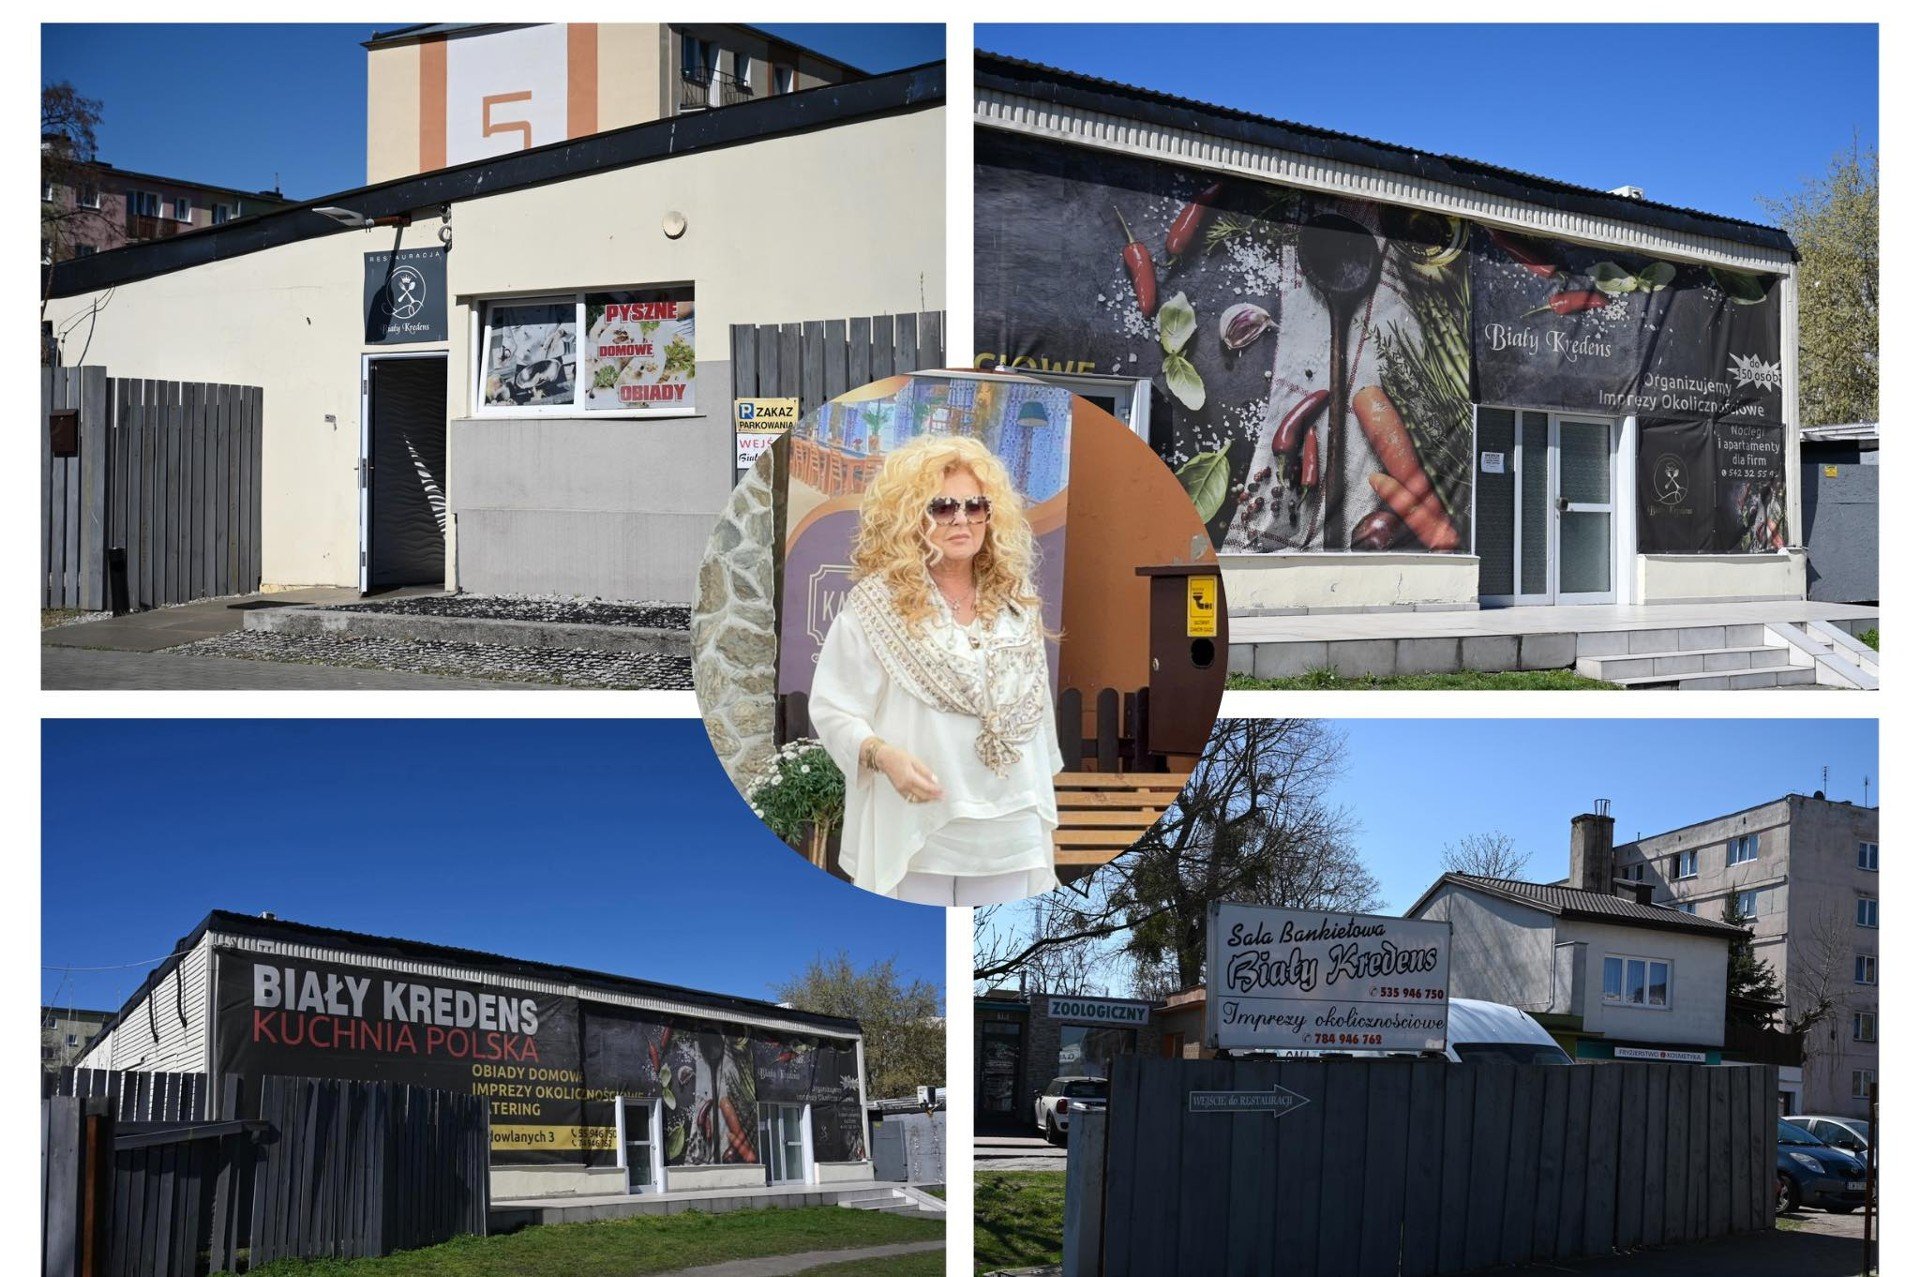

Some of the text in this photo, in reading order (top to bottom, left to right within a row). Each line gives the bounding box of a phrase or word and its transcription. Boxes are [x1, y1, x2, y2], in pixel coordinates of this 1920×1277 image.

[369, 251, 441, 262] RESAURACJA
[605, 301, 678, 322] PYSZNE
[402, 321, 430, 335] Kredens
[600, 343, 653, 357] DOMOWE
[1484, 323, 1612, 362] Biały Kredens
[1750, 359, 1760, 368] do
[1754, 369, 1780, 382] osób
[1644, 372, 1732, 397] Organizujemy
[620, 384, 687, 402] OBIADY
[756, 406, 794, 417] ZAKAZ
[739, 421, 794, 430] PARKOWANIA
[1723, 441, 1781, 454] apartamenty
[1732, 454, 1767, 466] dla firm
[1227, 917, 1386, 947] Sala Bankietowa
[1227, 940, 1438, 993] Biały Kredens
[253, 963, 539, 1036] BIAŁY KREDENS
[1380, 986, 1444, 1000] 535 946 750
[1051, 1001, 1146, 1021] ZOOLOGICZNY
[1223, 1001, 1445, 1034] Imprezy okolicznościowe
[253, 1008, 540, 1063] KUCHNIA POLSKA
[1314, 1032, 1382, 1045] 784 946 762
[472, 1064, 584, 1083] OBIADY DOMOW
[472, 1082, 533, 1098] IMPREZY
[491, 1101, 541, 1117] TERING
[548, 1131, 555, 1143] 3
